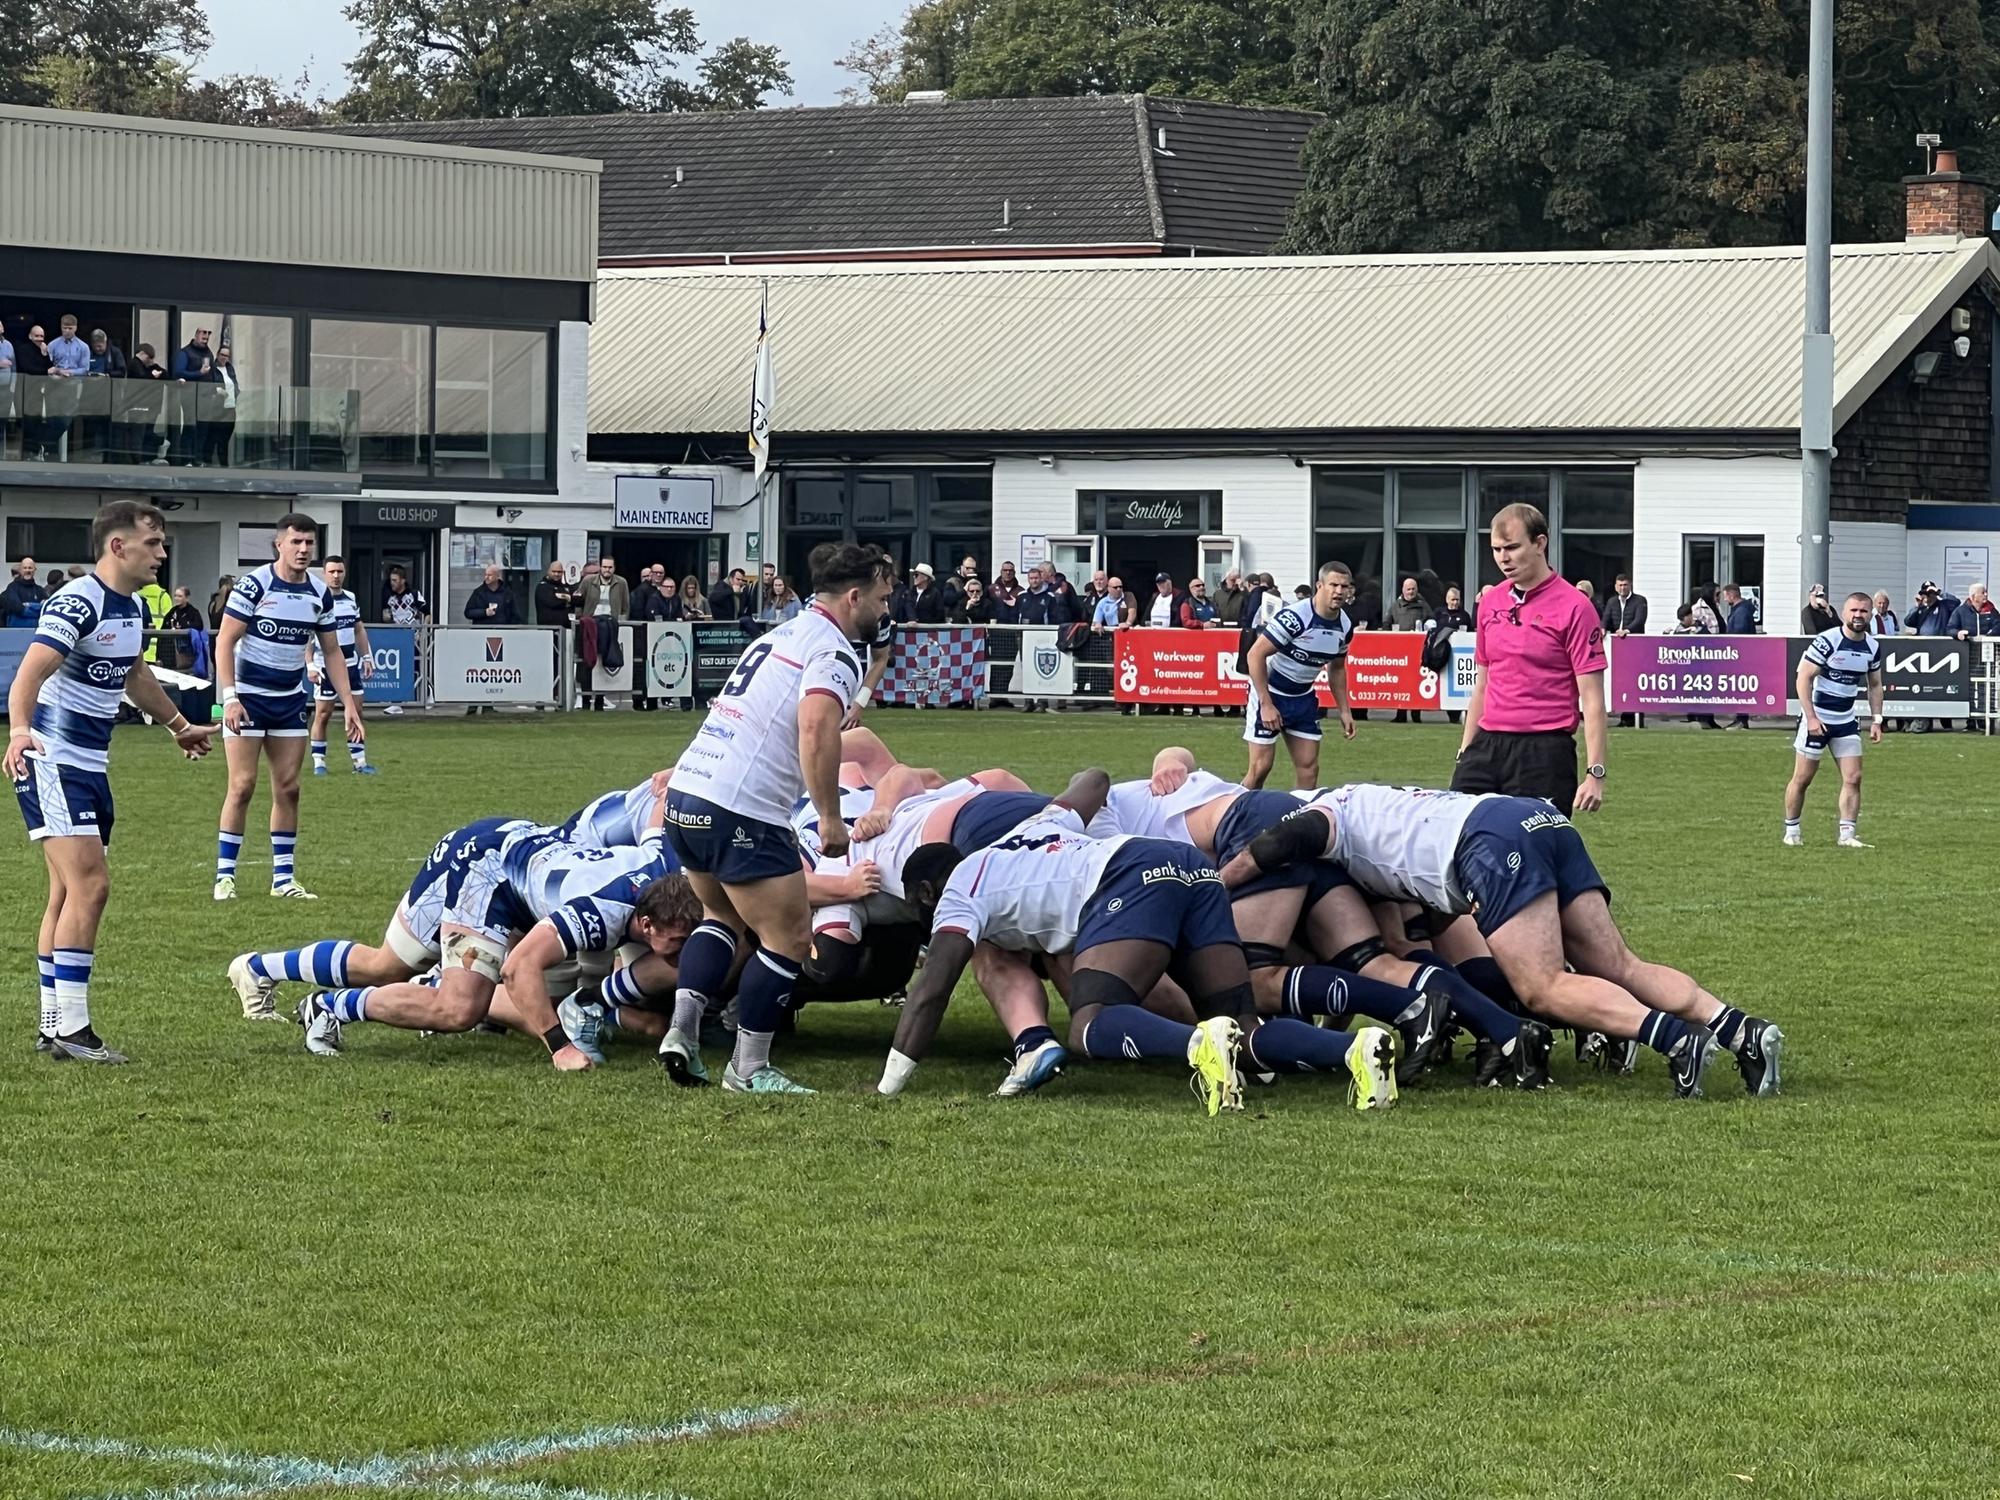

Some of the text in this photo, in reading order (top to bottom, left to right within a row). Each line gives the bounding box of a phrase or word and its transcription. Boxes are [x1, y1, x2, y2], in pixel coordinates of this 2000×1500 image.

[378, 507, 438, 522] CLUB SHOP
[620, 510, 709, 526] MAIN ENTRANCE
[1125, 499, 1184, 529] Smithy's
[1153, 651, 1205, 662] Workwear
[1658, 646, 1739, 660] Brooklands
[664, 662, 675, 672] etc
[726, 657, 739, 666] SHO
[1347, 655, 1408, 667] Promotional
[466, 668, 521, 683] MORSON
[724, 643, 773, 696] 9
[1154, 668, 1205, 679] Teamwear
[1356, 672, 1399, 685] Bespoke
[1638, 673, 1759, 692] 0161 243 5100
[1357, 691, 1411, 701] 0333 772 9122
[1142, 861, 1178, 886] penk
